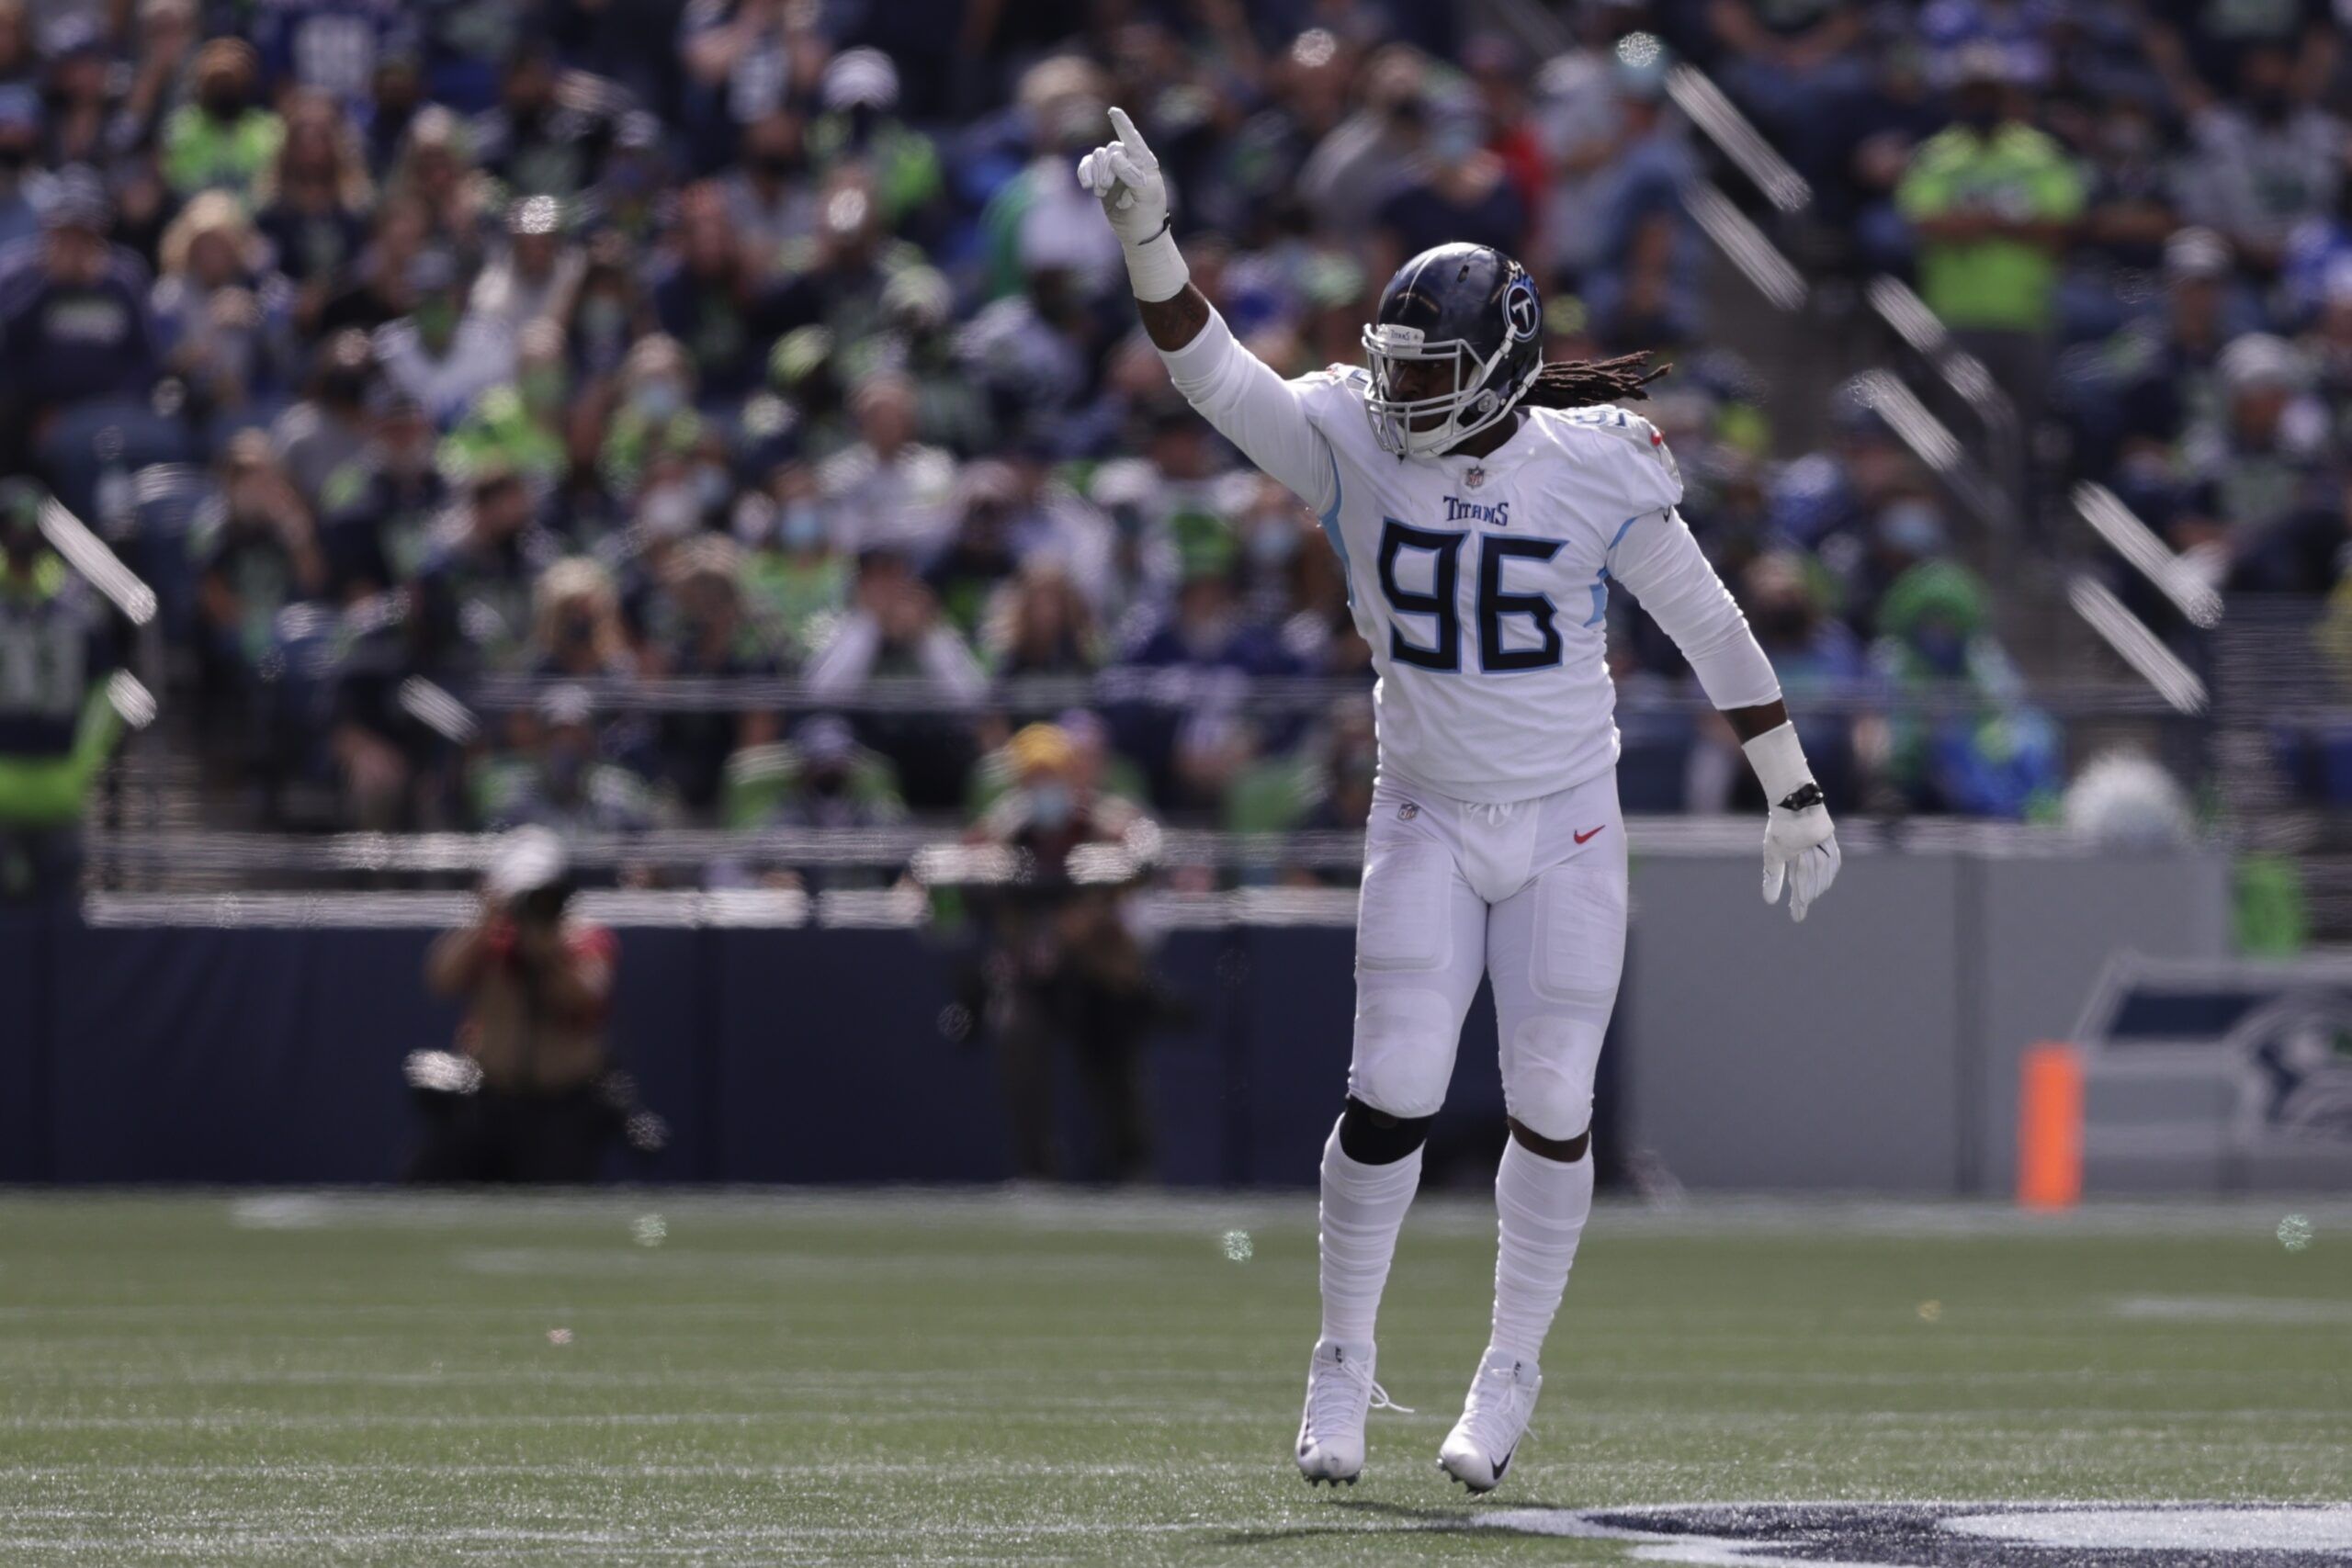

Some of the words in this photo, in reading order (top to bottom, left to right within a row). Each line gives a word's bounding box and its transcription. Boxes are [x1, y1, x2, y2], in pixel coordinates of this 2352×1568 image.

[1510, 298, 1532, 330] T
[1443, 496, 1509, 526] TITANS
[1376, 516, 1570, 674] 96
